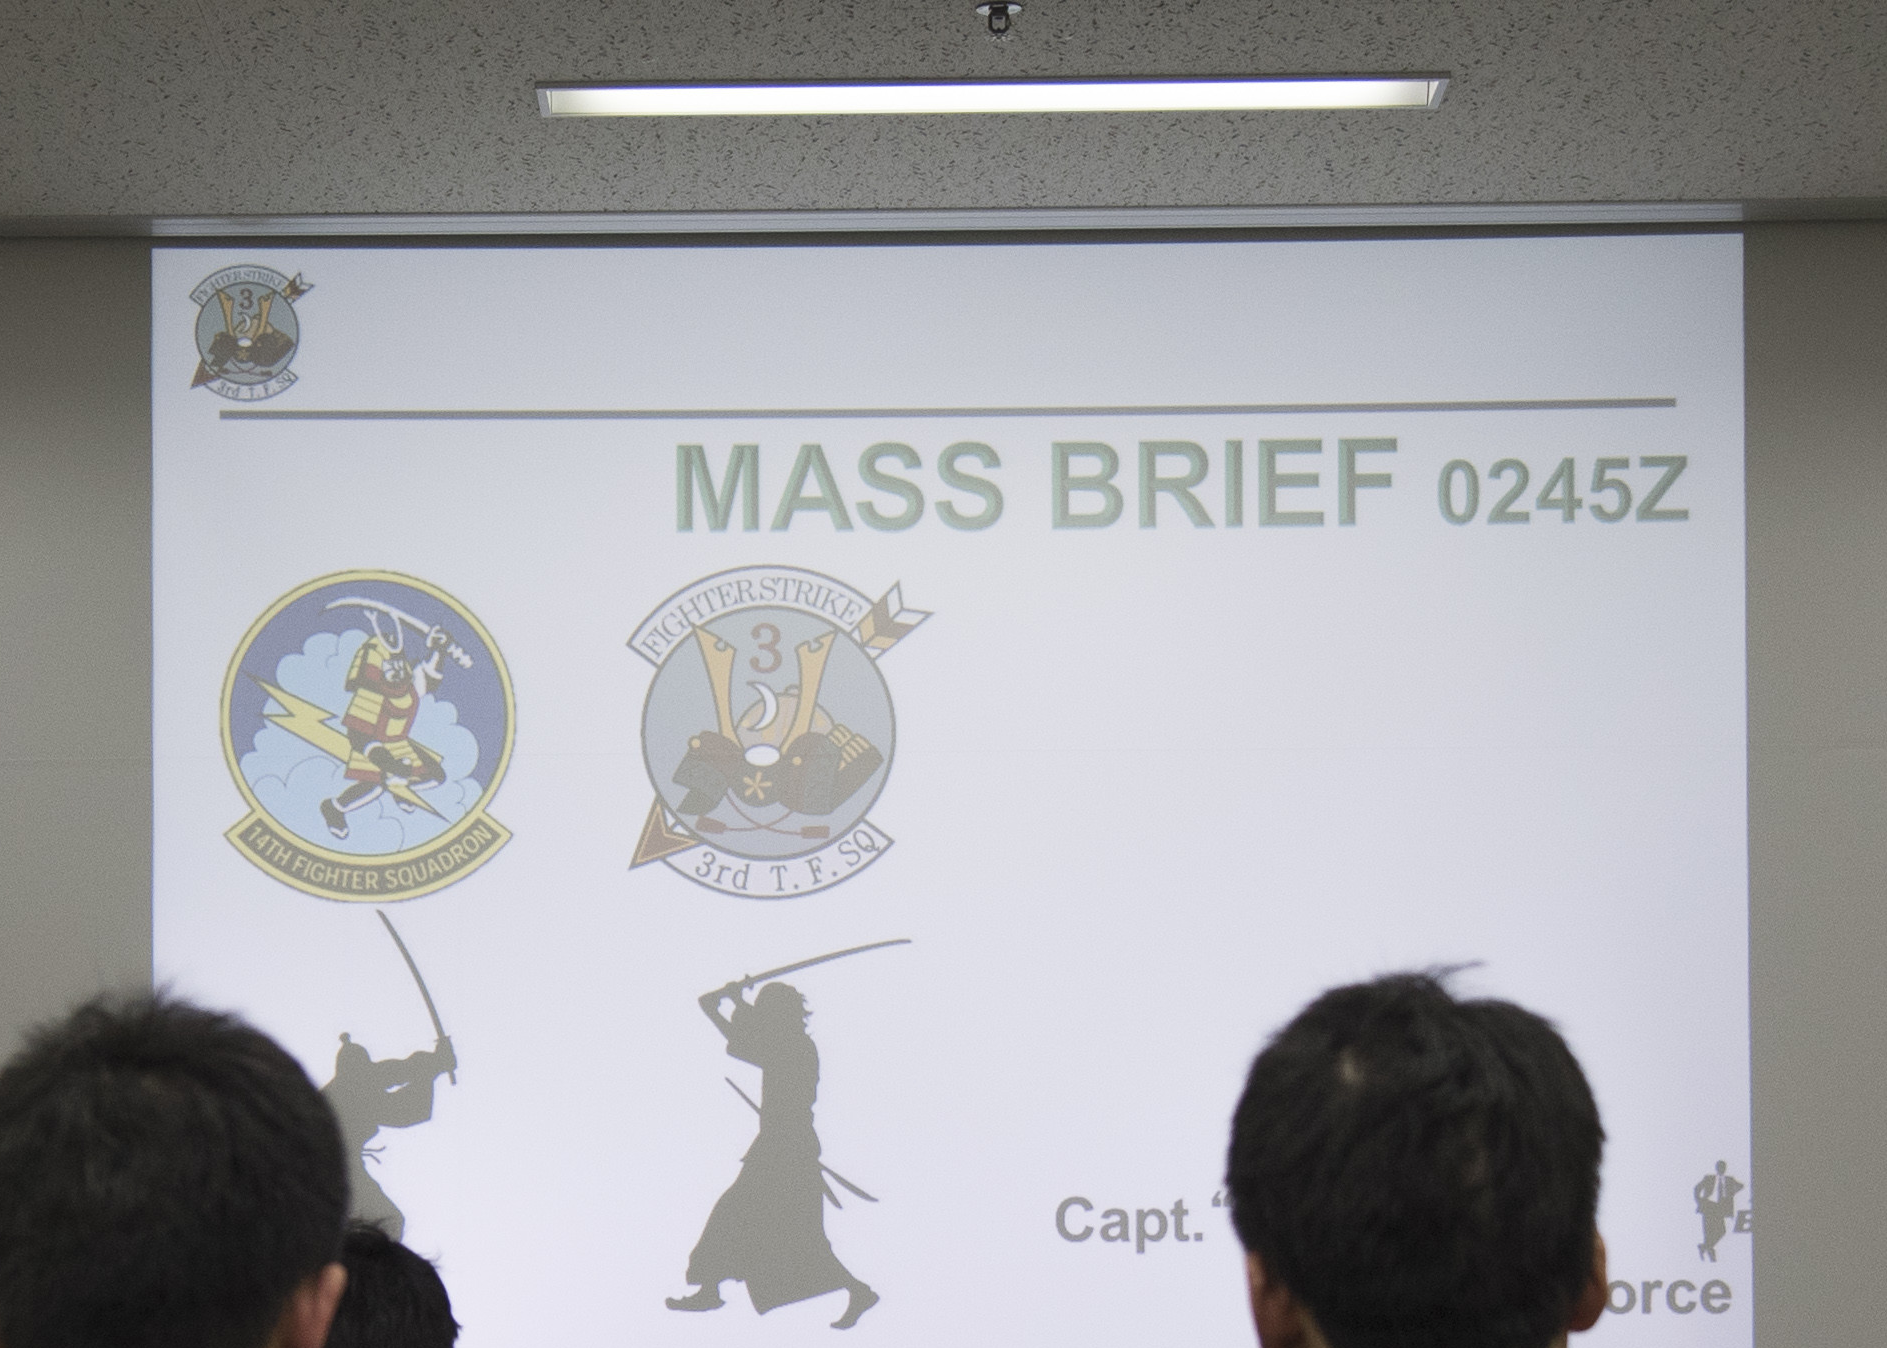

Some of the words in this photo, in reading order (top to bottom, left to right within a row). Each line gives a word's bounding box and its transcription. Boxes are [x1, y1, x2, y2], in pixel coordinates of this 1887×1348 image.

[239, 288, 253, 310] 3
[676, 441, 1005, 532] MASS
[1051, 437, 1398, 529] BRIEF
[1438, 456, 1689, 525] 0245Z
[749, 623, 782, 674] 3
[247, 826, 291, 866] 14TH
[292, 855, 379, 891] FIGHTER
[385, 824, 492, 889] SQUADRON
[695, 851, 750, 890] 3rd
[1055, 1196, 1204, 1253] Capt.
[1606, 1279, 1732, 1315] orce
